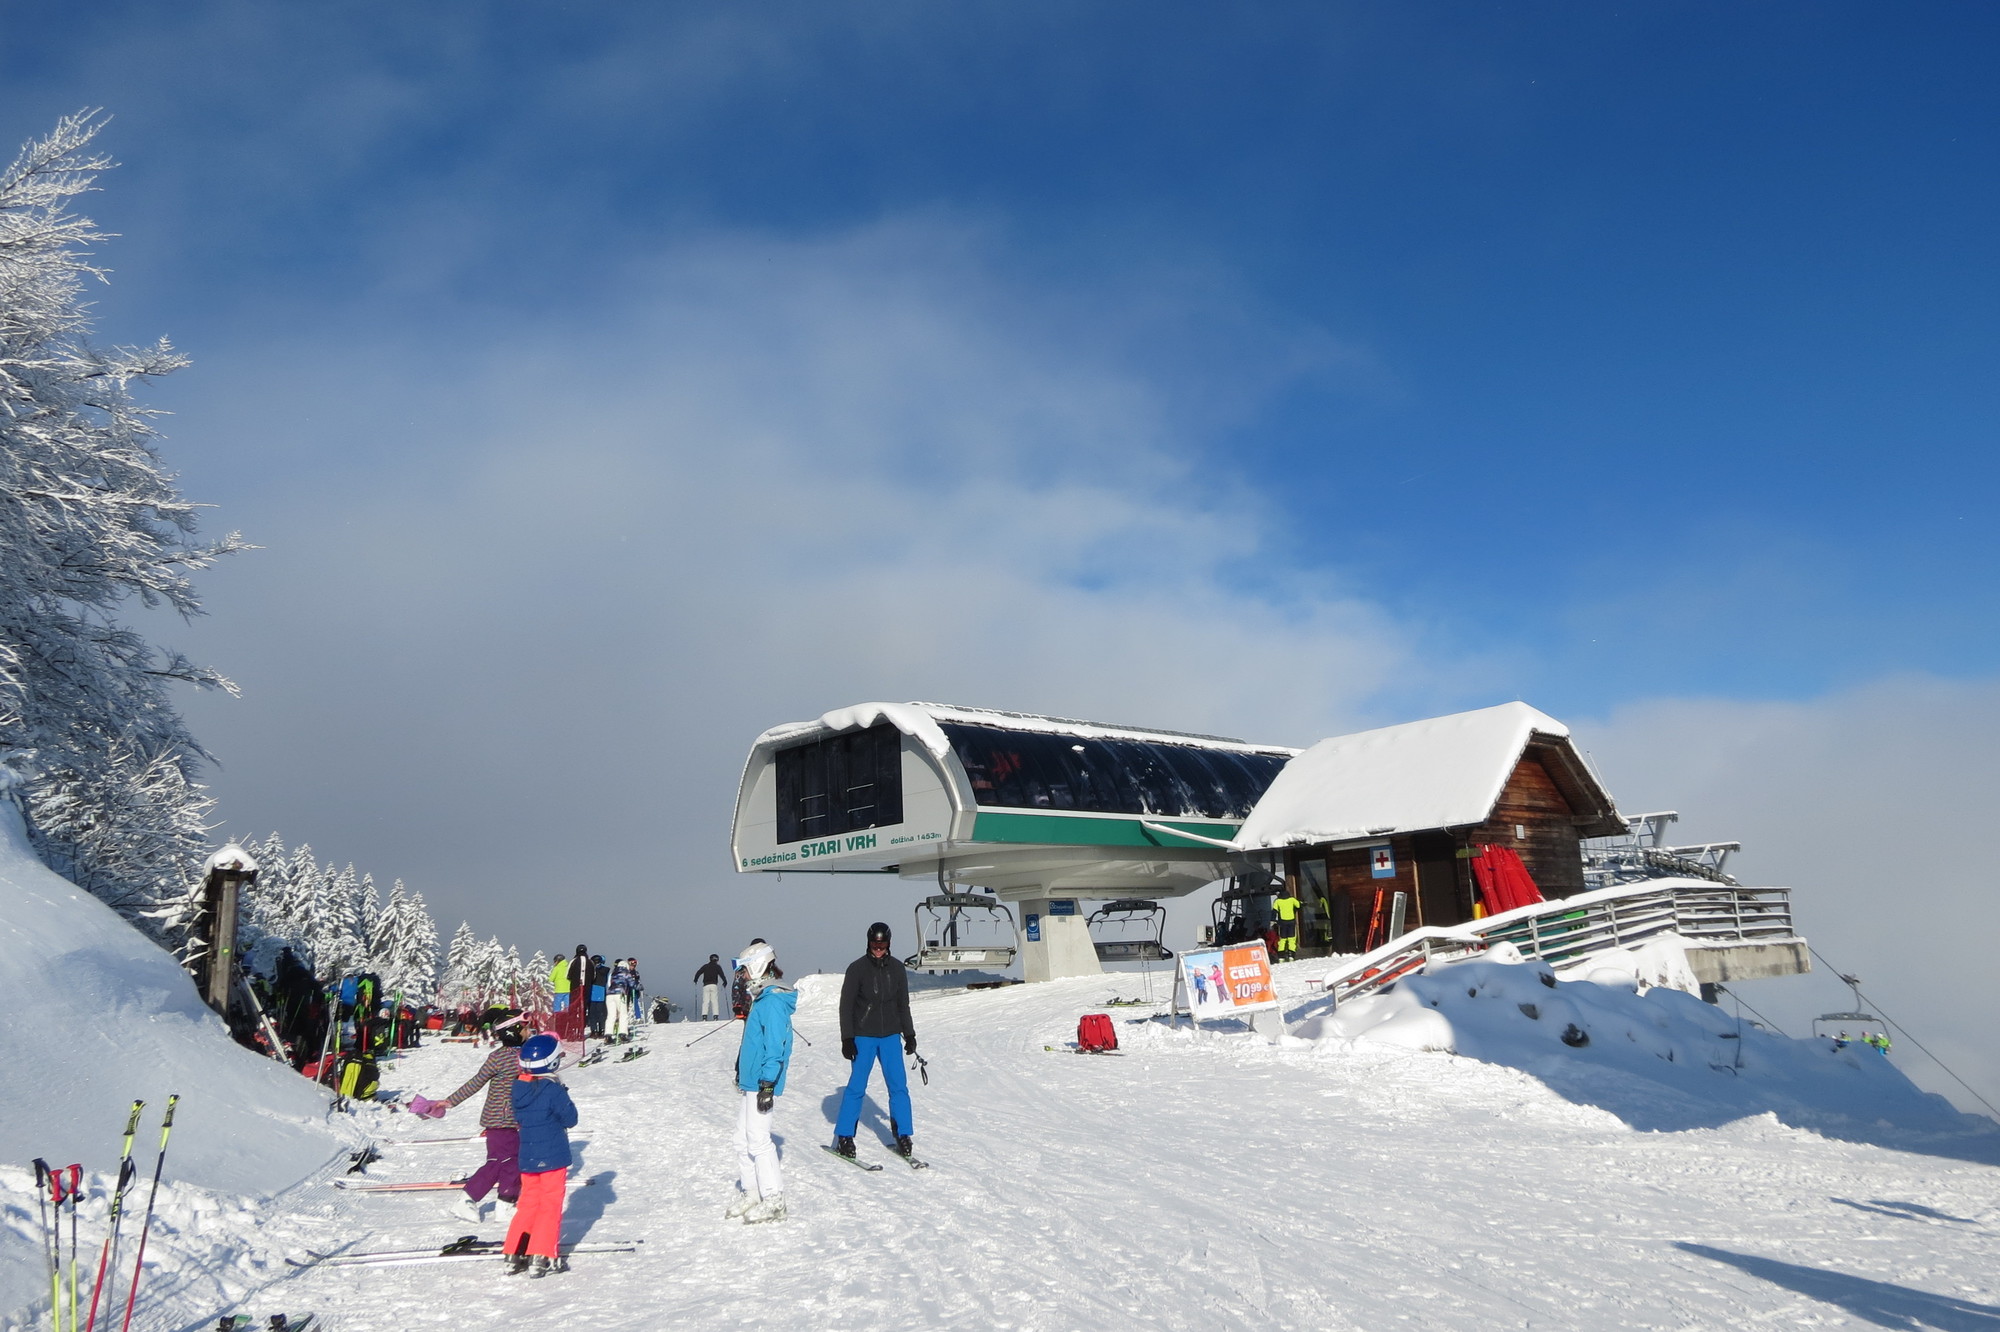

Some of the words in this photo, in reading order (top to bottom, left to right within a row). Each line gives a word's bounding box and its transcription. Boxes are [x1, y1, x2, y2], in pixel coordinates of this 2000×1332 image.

[742, 858, 748, 867] 6
[750, 851, 797, 866] sedežnica
[801, 839, 841, 858] STARI
[846, 833, 877, 851] VRH
[1230, 966, 1261, 980] CENE
